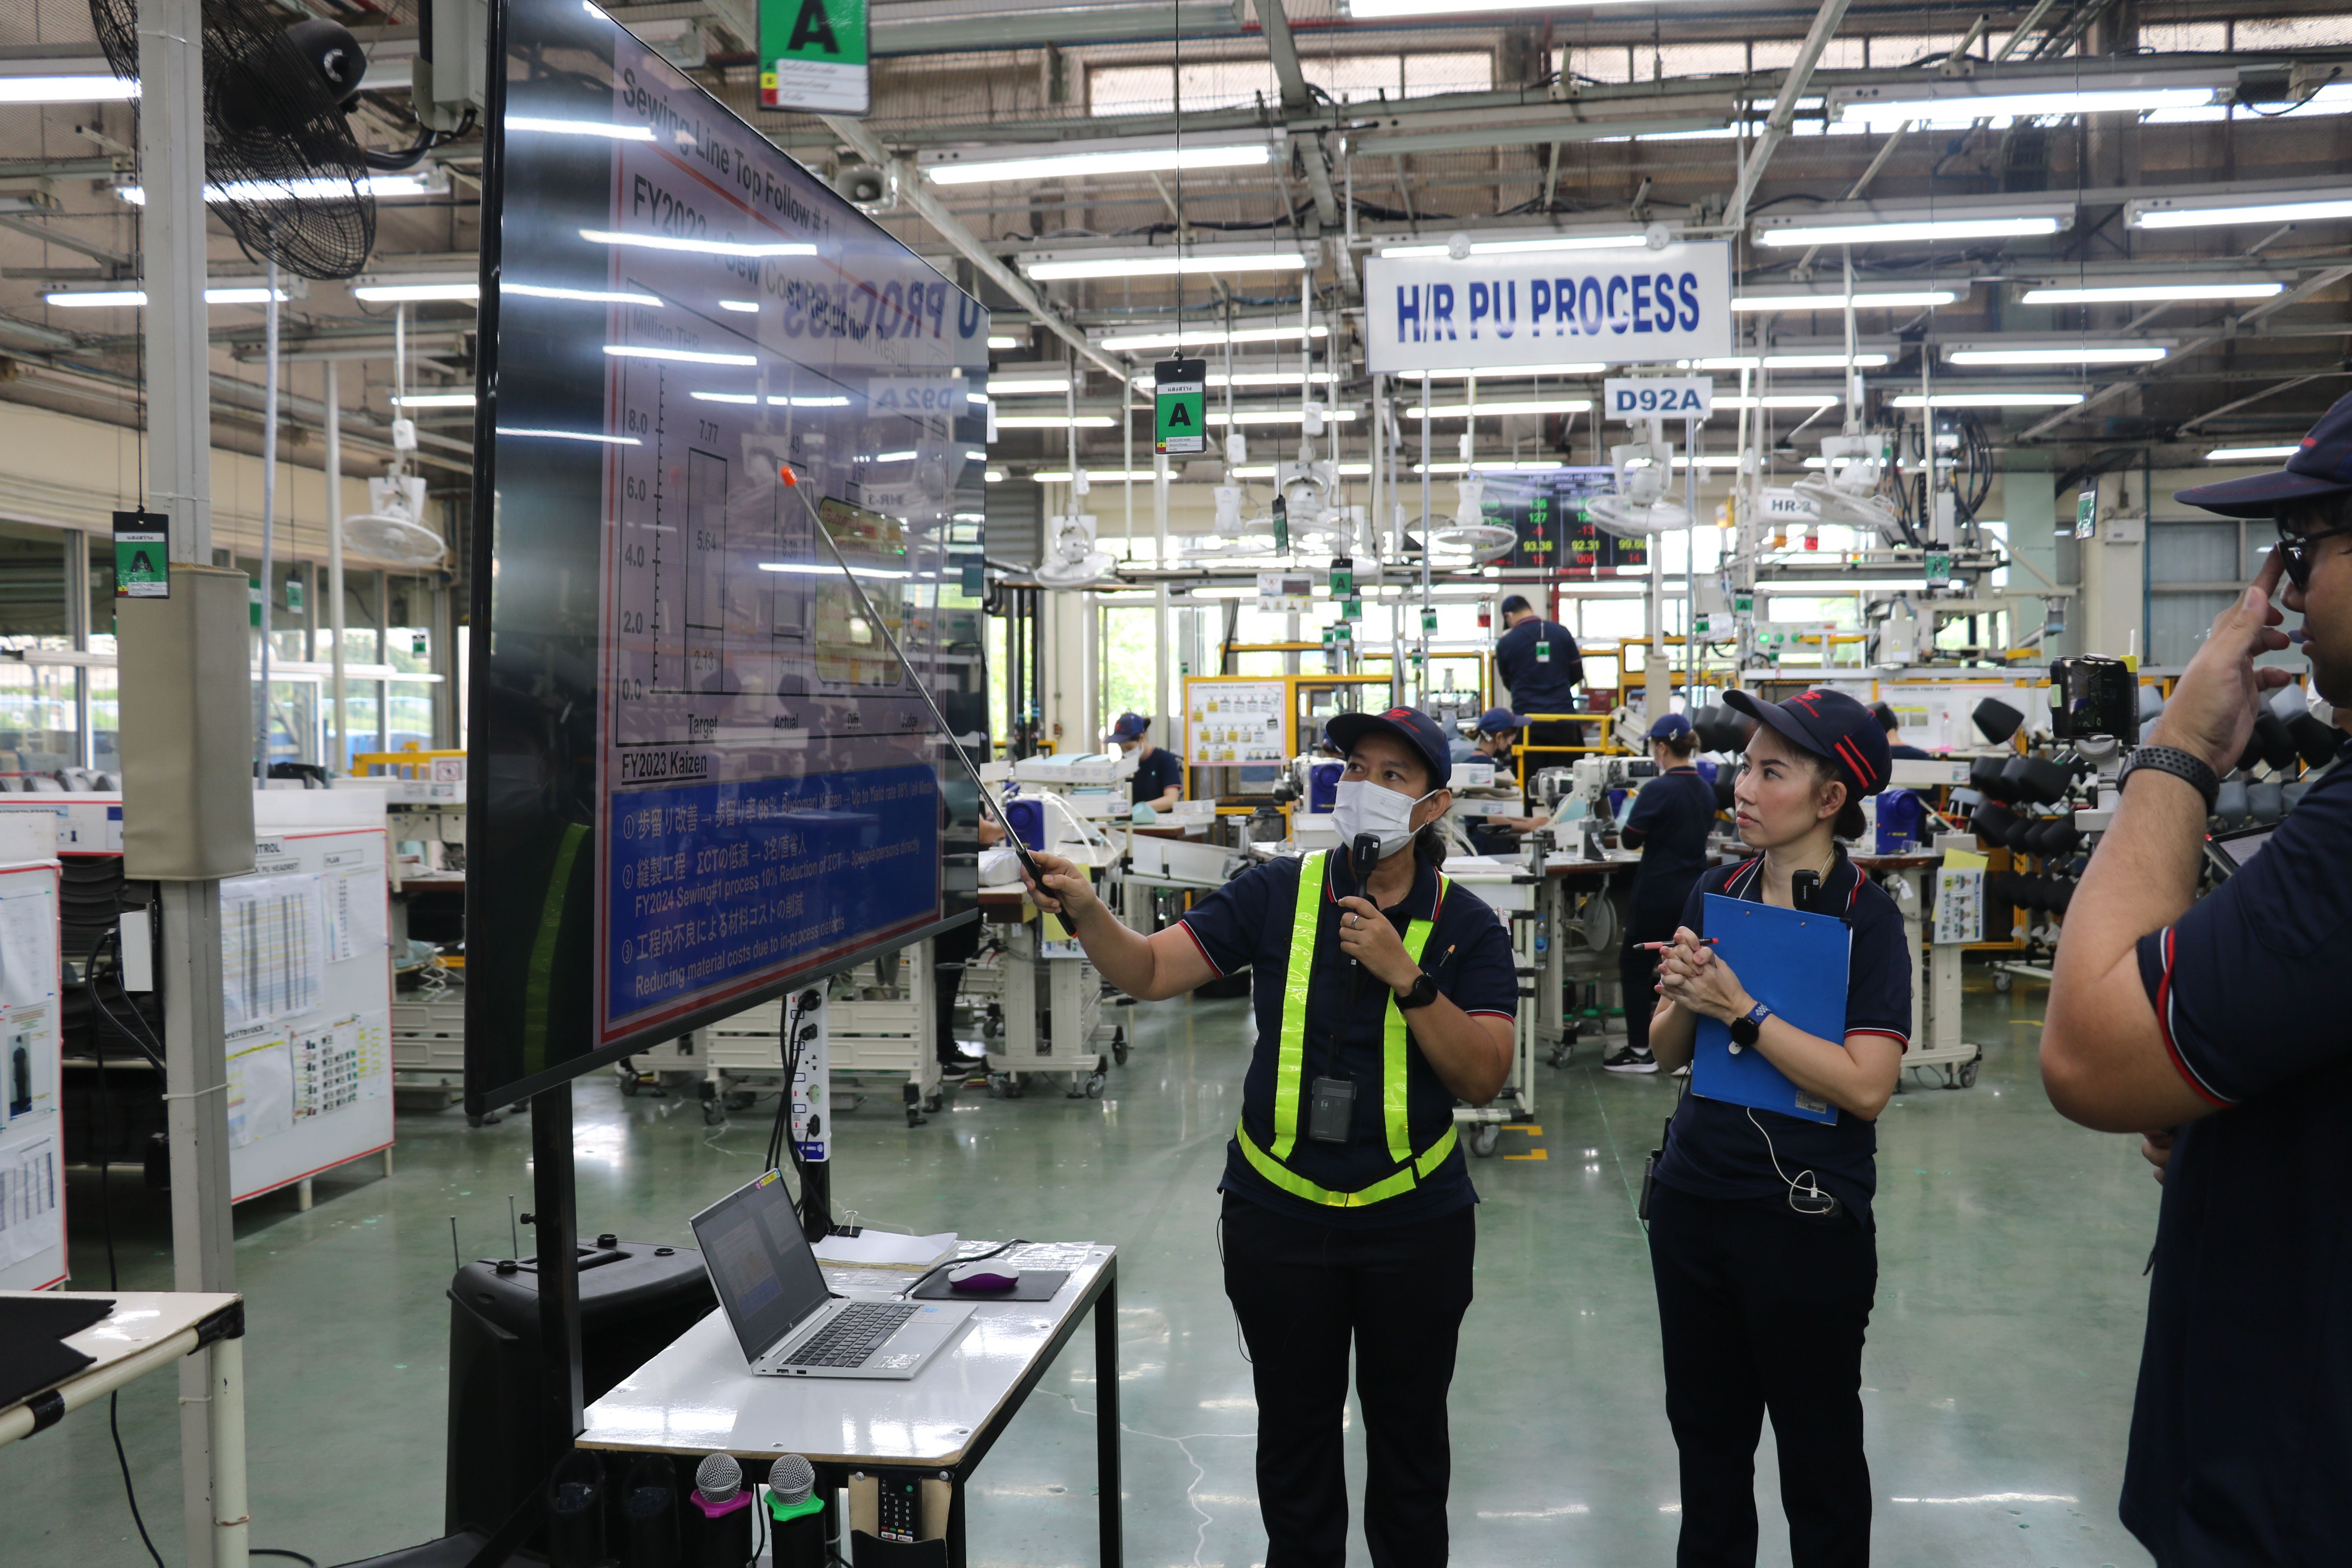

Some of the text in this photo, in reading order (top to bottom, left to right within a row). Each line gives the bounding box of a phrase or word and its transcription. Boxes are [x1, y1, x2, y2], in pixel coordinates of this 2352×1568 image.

[786, 0, 839, 54] A
[623, 68, 690, 156] Sewing
[696, 120, 729, 174] Line
[734, 147, 760, 202] Top
[766, 171, 810, 229] Follow
[765, 257, 800, 311] Cost
[806, 279, 870, 350] Reduction
[875, 323, 911, 373] Result
[1396, 272, 1700, 343] H/R PU PROCESS
[633, 307, 673, 345] Million
[1617, 388, 1703, 412] D92A
[628, 409, 648, 435] 8.0
[1168, 403, 1192, 427] A
[699, 419, 719, 443] 7.77
[626, 475, 646, 501] 6.0
[1529, 499, 1548, 509] 136
[1528, 512, 1548, 523] 127
[697, 530, 717, 553] 5.64
[1577, 525, 1594, 535] -13
[625, 543, 645, 568] 4.0
[1523, 539, 1646, 552] 93.38 92.31 99.60
[130, 550, 155, 572] A
[1533, 554, 1545, 564] 12
[1628, 553, 1640, 563] 14
[1933, 560, 1944, 572] A
[1336, 577, 1346, 589] A
[1347, 603, 1357, 613] A
[1739, 601, 1748, 609] A
[623, 610, 643, 634] 2.0
[1426, 619, 1433, 627] A
[622, 678, 642, 701] 0.0
[688, 713, 918, 739] Target Actual Diff. Judge
[622, 750, 707, 779] FY2023 Kaizen
[638, 803, 698, 840] 歩留り改善
[715, 797, 756, 828] 歩留り率
[758, 795, 778, 820] 86%
[782, 793, 818, 815] Budomari
[819, 793, 842, 810] Kaizen
[852, 788, 861, 808] Up
[862, 789, 868, 804] to
[869, 784, 884, 802] Yield
[635, 889, 674, 918] FY2024
[677, 878, 722, 907] Sewing#1
[724, 874, 759, 902] process
[762, 866, 777, 888] 10%
[780, 855, 818, 883] Reduction
[819, 853, 826, 874] of
[900, 836, 920, 855] directly
[637, 852, 686, 889] 縫製工程
[636, 891, 804, 960] 工程内不良による材料コストの削減
[636, 916, 845, 998] Reducing material costs due to in-process defects
